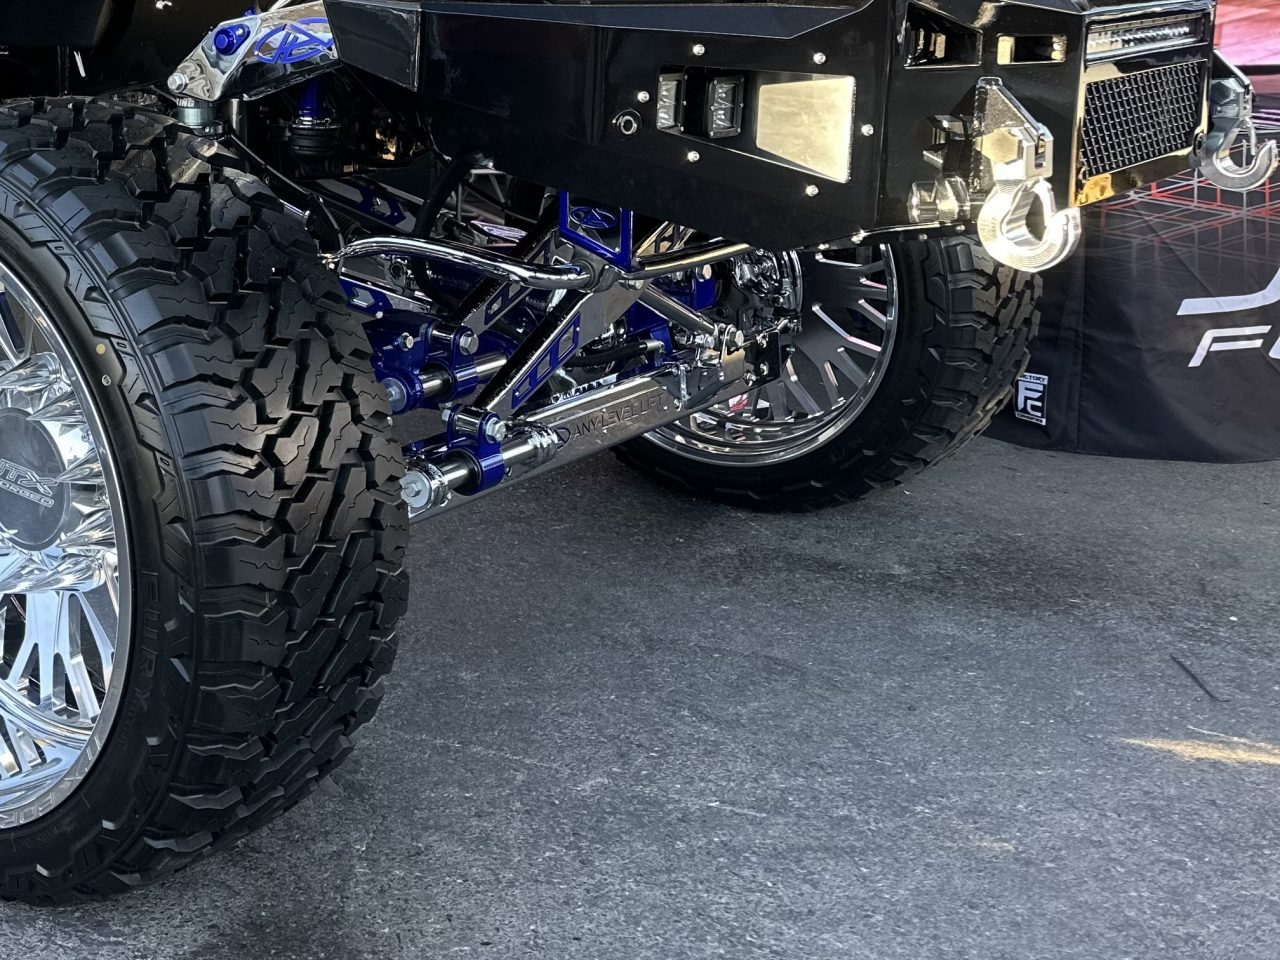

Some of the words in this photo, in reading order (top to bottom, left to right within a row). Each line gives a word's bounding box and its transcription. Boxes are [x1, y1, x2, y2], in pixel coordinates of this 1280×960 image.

[574, 417, 601, 438] ANY
[601, 403, 639, 427] LEVEL
[639, 393, 664, 414] LIFT
